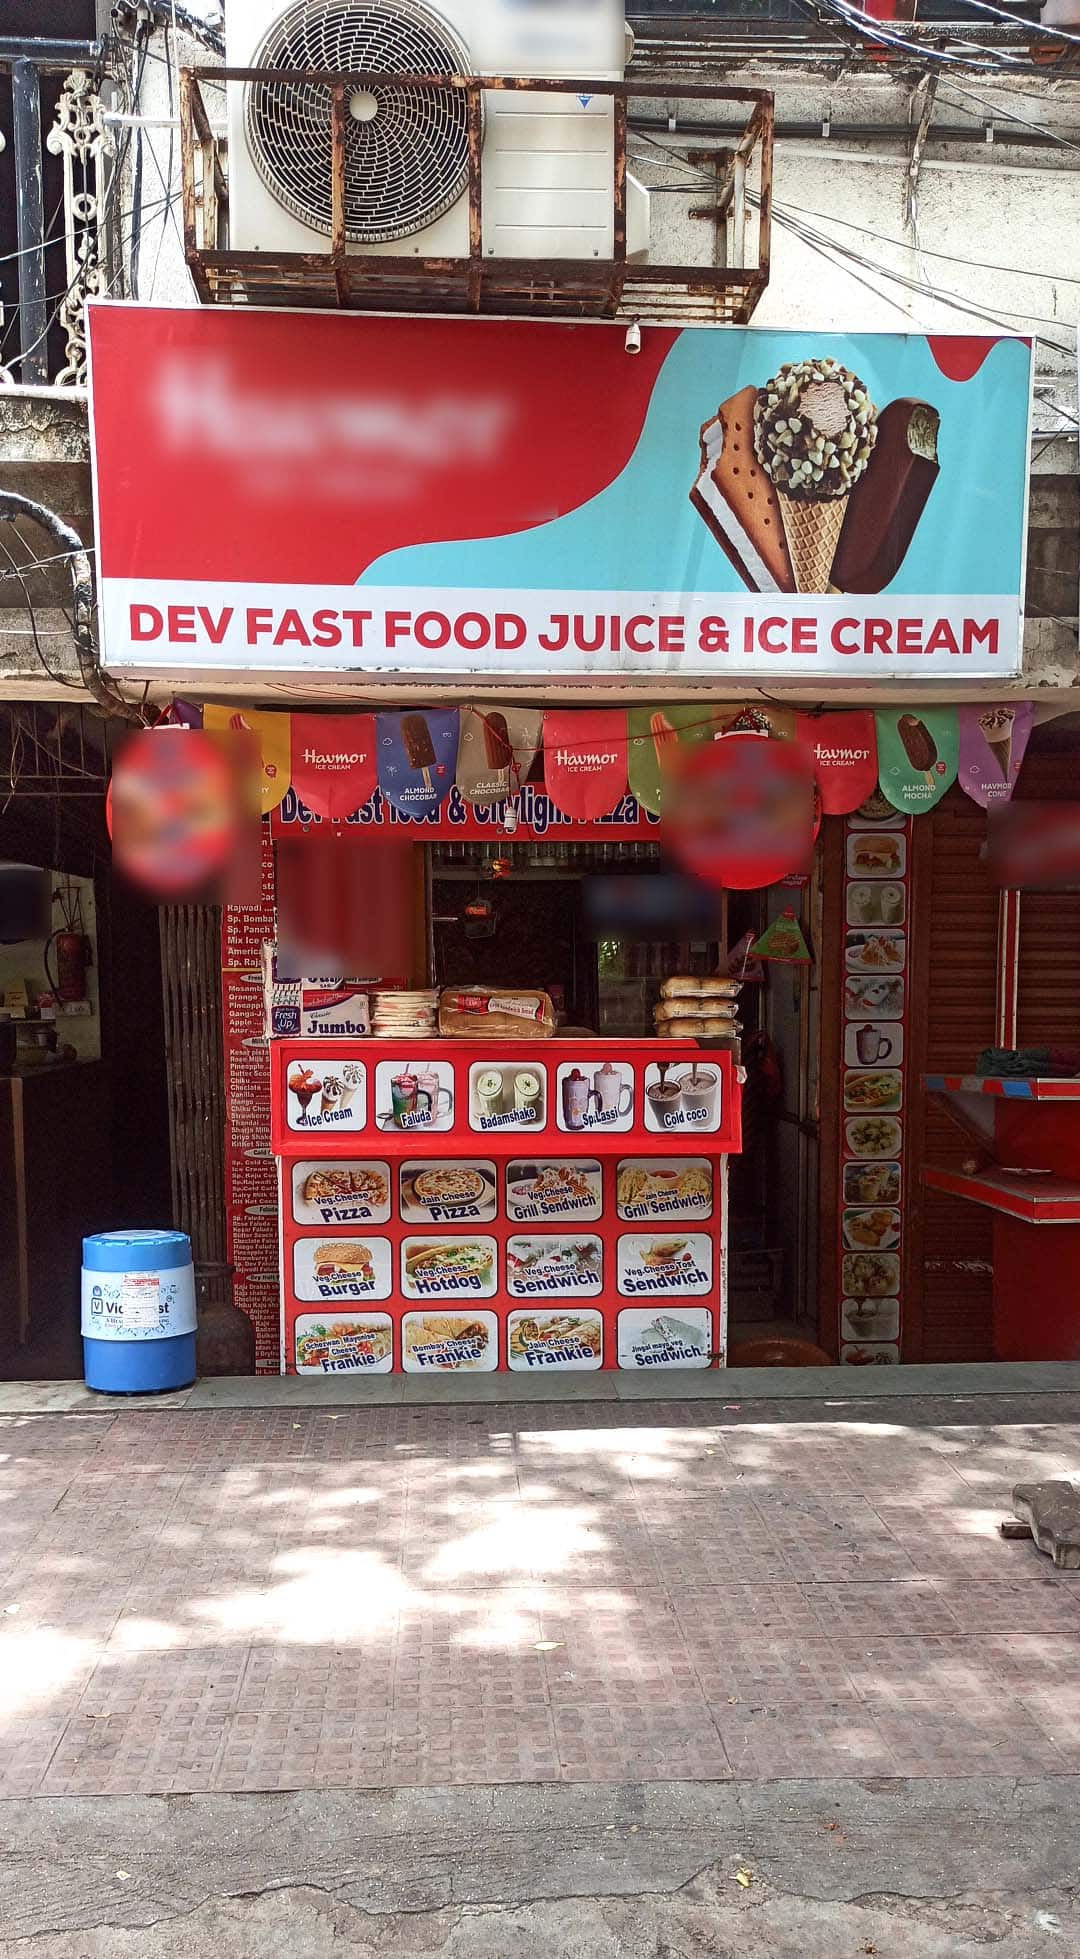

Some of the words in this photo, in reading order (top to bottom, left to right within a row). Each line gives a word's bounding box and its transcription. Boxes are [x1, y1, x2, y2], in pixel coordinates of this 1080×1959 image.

[130, 604, 234, 643] DEV
[246, 609, 372, 647] FAST
[386, 611, 527, 650] FOOD
[538, 614, 685, 653] JUICE
[699, 615, 730, 653] &
[744, 616, 817, 653] ICE
[831, 618, 999, 655] CREAM
[301, 749, 367, 763] Havmor
[554, 750, 618, 766] Havmor
[400, 793, 437, 801] CHOCOBAR
[448, 785, 467, 824] &
[275, 1011, 297, 1019] Fresh
[280, 1019, 293, 1028] Up
[308, 1021, 366, 1034] Jumbo
[307, 1112, 323, 1127] Ice
[324, 1107, 353, 1122] Cream
[402, 1110, 431, 1127] Faluda
[480, 1108, 535, 1129] Badamshake
[665, 1111, 685, 1126] Cold
[687, 1108, 708, 1122] coco
[314, 1191, 369, 1206] Veg.Cheese
[421, 1194, 440, 1205] Jain
[442, 1190, 476, 1201] Cheese
[528, 1186, 573, 1200] Veg.Cheese
[657, 1188, 678, 1198] Cheese
[429, 1204, 480, 1221] Pizza
[514, 1204, 539, 1220] Grill
[541, 1194, 596, 1215] Sendwich
[624, 1203, 649, 1218] Grill
[651, 1193, 706, 1213] Sendwich
[321, 1206, 372, 1223] Pizza
[416, 1264, 468, 1278] Veg.Cheese
[525, 1263, 576, 1276] Veg.Cheese
[676, 1259, 696, 1270] Tost
[312, 1270, 362, 1283] Veg.Cheese
[415, 1275, 482, 1294] Hotdog
[513, 1270, 600, 1294] Sendwich
[623, 1268, 709, 1293] Sendwich
[318, 1280, 376, 1297] Burgar
[331, 1346, 357, 1355] Cheese
[412, 1342, 445, 1353] Bombay
[446, 1337, 476, 1349] Cheese
[528, 1340, 547, 1350] Jain
[549, 1336, 580, 1347] Cheese
[671, 1340, 683, 1348] veg
[321, 1353, 376, 1373] Frankie
[417, 1347, 482, 1367] Frankie
[525, 1346, 594, 1367] Frankie
[635, 1345, 702, 1367] Sendwich
